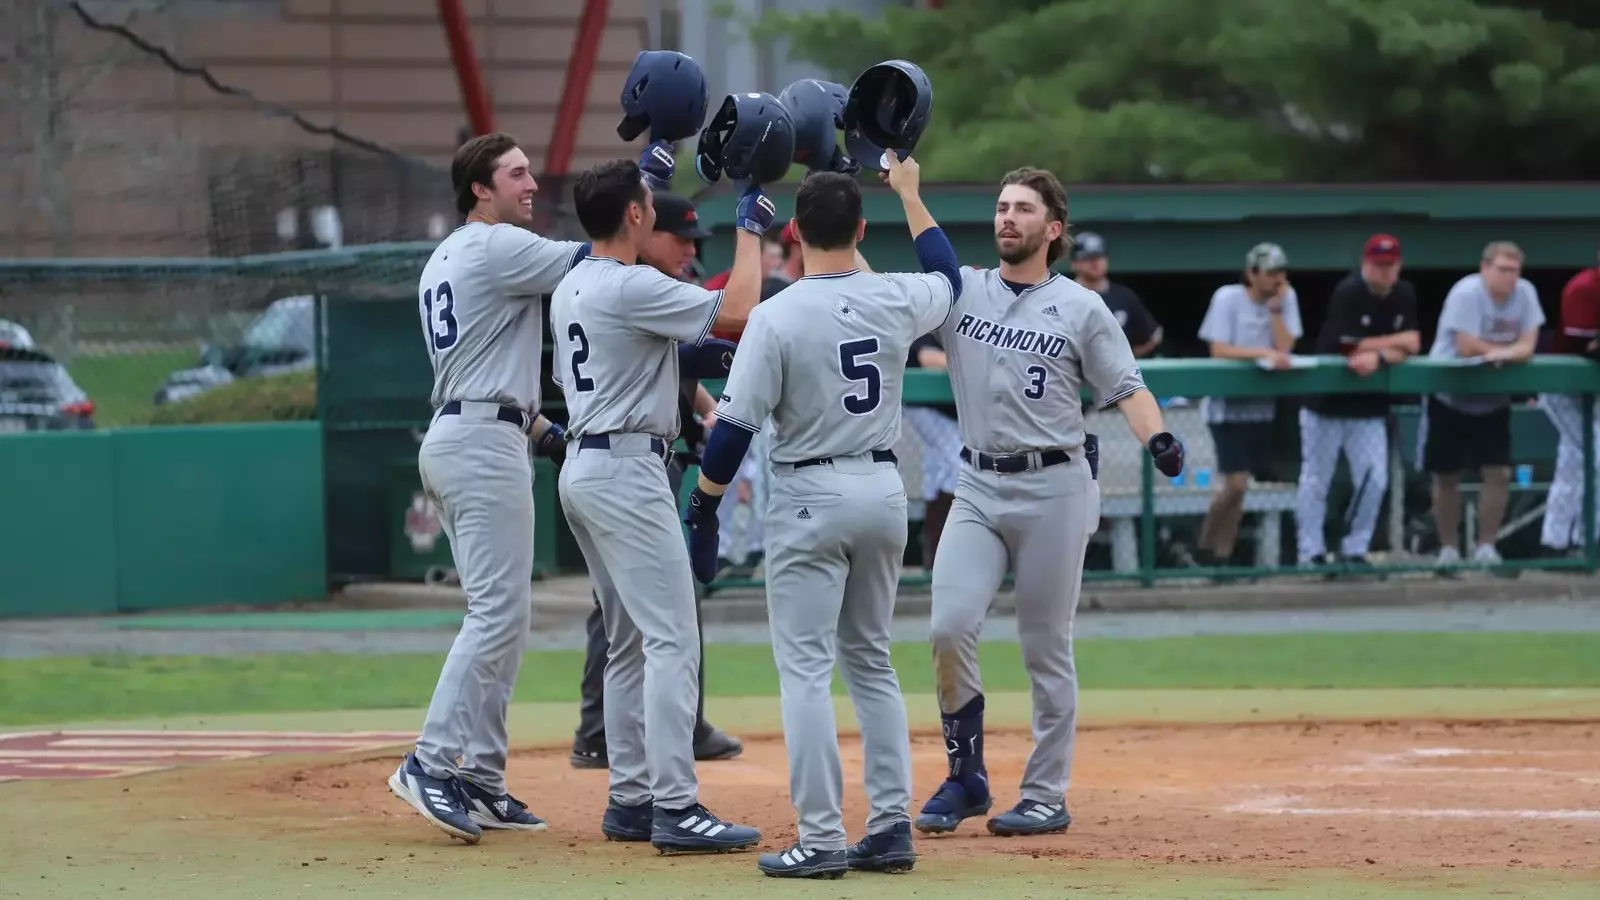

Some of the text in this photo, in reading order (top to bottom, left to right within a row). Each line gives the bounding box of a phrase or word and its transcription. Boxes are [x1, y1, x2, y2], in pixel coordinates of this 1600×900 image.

[423, 280, 459, 355] 13
[955, 313, 1067, 359] RICHMOND
[567, 322, 596, 392] 2
[838, 336, 882, 416] 5
[1023, 364, 1047, 400] 3
